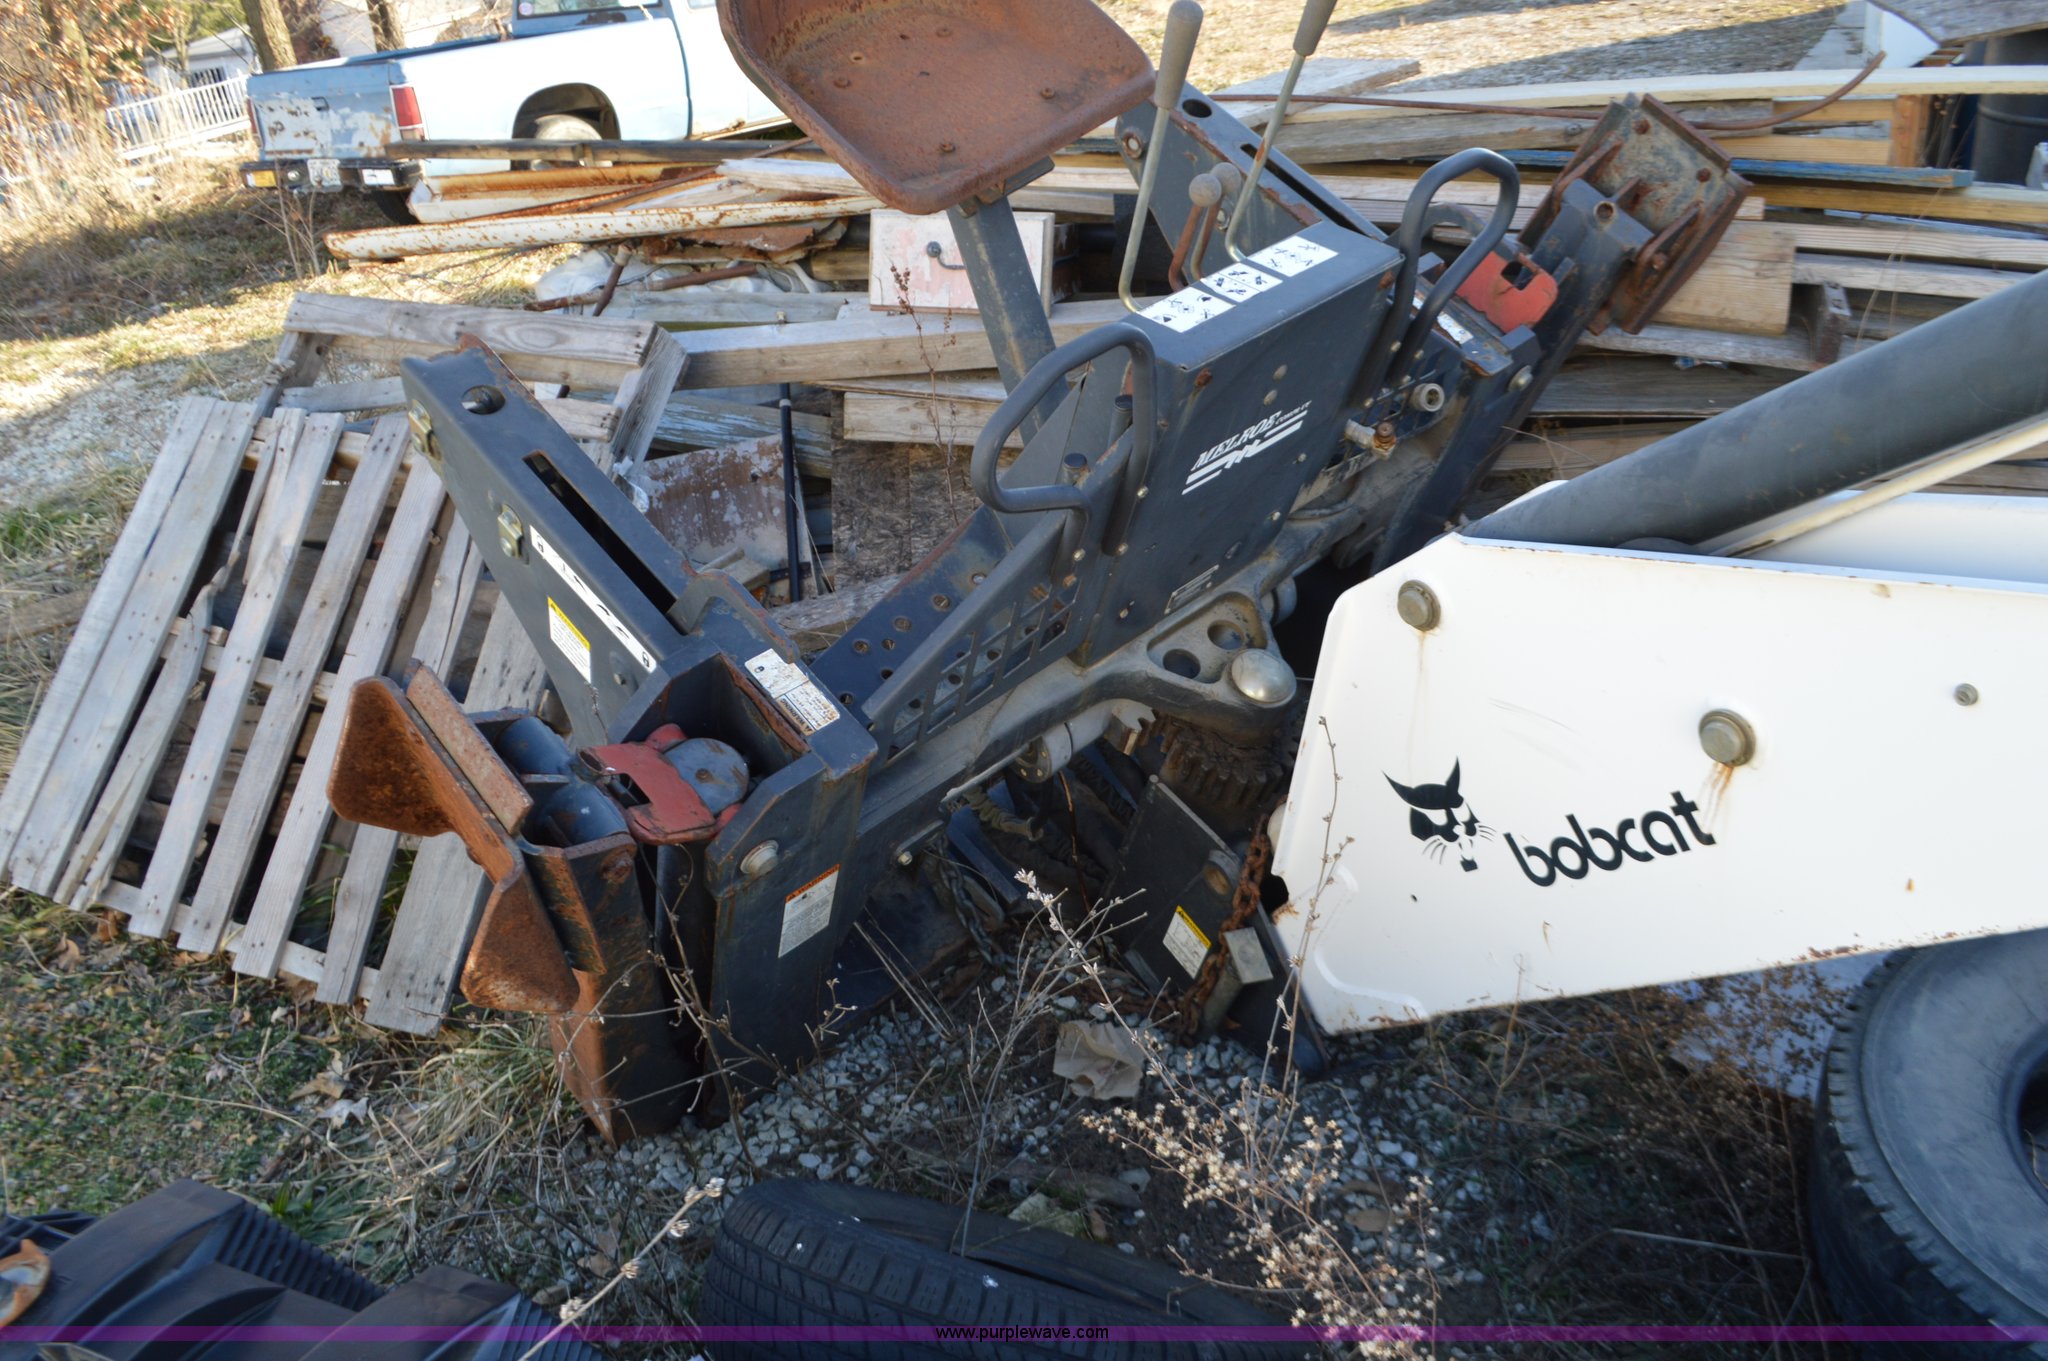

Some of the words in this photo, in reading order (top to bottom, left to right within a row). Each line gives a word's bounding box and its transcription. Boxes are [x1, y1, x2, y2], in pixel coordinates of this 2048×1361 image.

[1190, 410, 1282, 472] MELROE
[780, 698, 805, 725] WARNING
[1503, 790, 1716, 887] bobcat
[797, 865, 838, 895] WARNING
